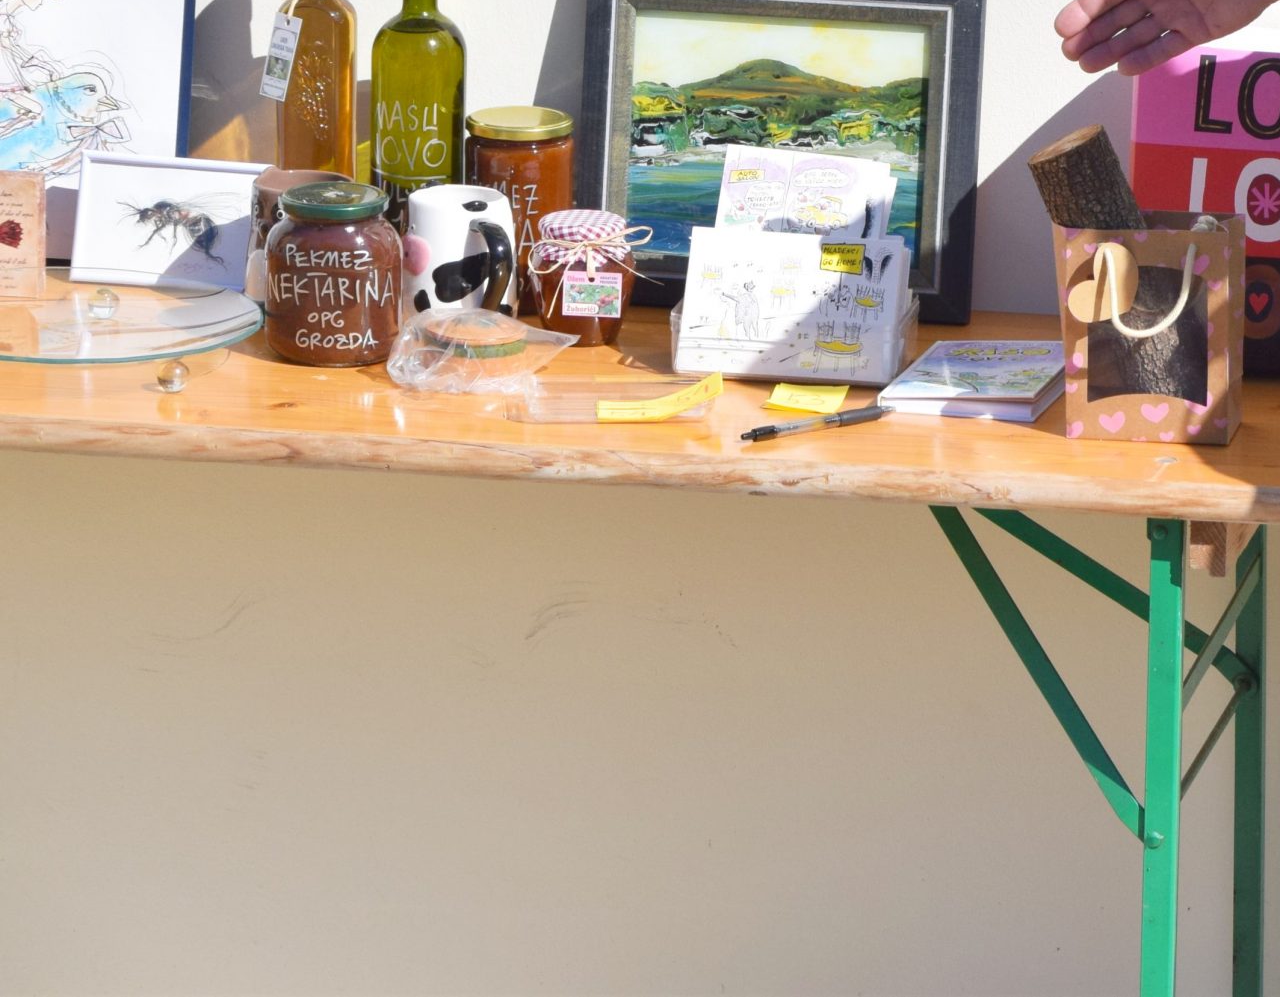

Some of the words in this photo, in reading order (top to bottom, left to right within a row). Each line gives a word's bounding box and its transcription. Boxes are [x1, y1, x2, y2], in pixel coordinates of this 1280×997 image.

[286, 243, 373, 271] PEKMEZ
[268, 268, 396, 308] NEKTARINA
[307, 310, 345, 329] OPG
[295, 328, 379, 351] GROZDA
